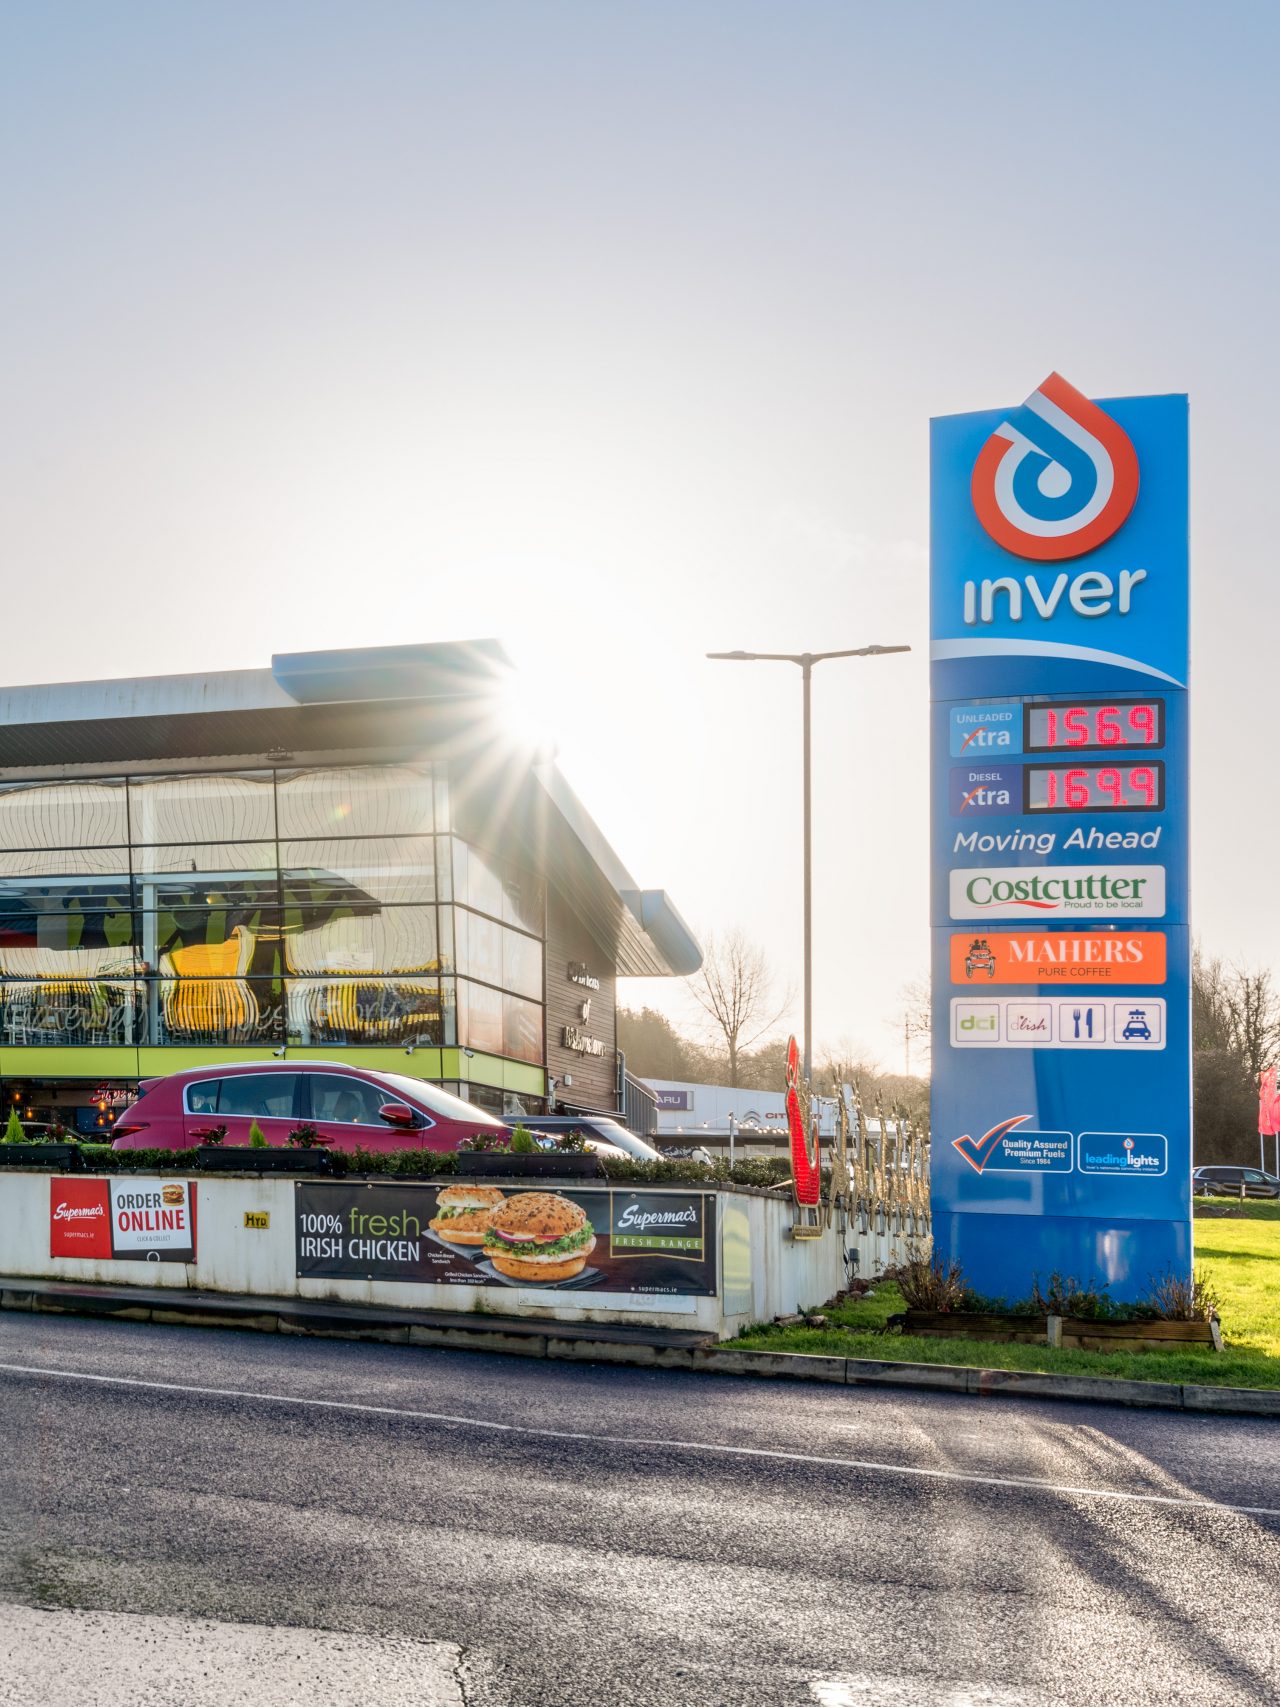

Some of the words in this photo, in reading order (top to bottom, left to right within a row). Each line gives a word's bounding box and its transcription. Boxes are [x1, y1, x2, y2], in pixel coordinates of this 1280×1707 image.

[963, 568, 1147, 625] inver
[956, 712, 1013, 725] UNLEADED
[1046, 705, 1155, 746] 156.9
[959, 726, 1011, 753] xtra
[969, 773, 1003, 782] DIESEL
[1046, 767, 1155, 808] 169.9
[959, 786, 1010, 813] xtra
[953, 829, 1056, 855] Moving
[1063, 826, 1162, 850] Ahead
[966, 874, 1147, 905] Costcutter
[1064, 901, 1092, 909] Proud
[1121, 900, 1143, 908] local
[1008, 939, 1144, 963] MAHERS
[1038, 967, 1067, 976] PURE
[1070, 967, 1112, 977] COFFEE
[960, 1015, 995, 1031] dci
[657, 1096, 681, 1104] ARU
[1002, 1139, 1032, 1149] Quality
[1033, 1139, 1068, 1149] Assured
[1005, 1149, 1041, 1157] Premium
[1043, 1149, 1065, 1158] Fuels
[53, 1203, 104, 1221] Supermac's
[117, 1193, 161, 1209] ORDER
[118, 1209, 185, 1231] ONLINE
[300, 1214, 342, 1234] 100%
[349, 1208, 420, 1237] fresh
[618, 1205, 697, 1231] Supermac's
[301, 1237, 343, 1258] IRISH
[349, 1239, 420, 1262] CHICKEN
[615, 1237, 652, 1247] FRESH
[661, 1239, 699, 1248] RANGE
